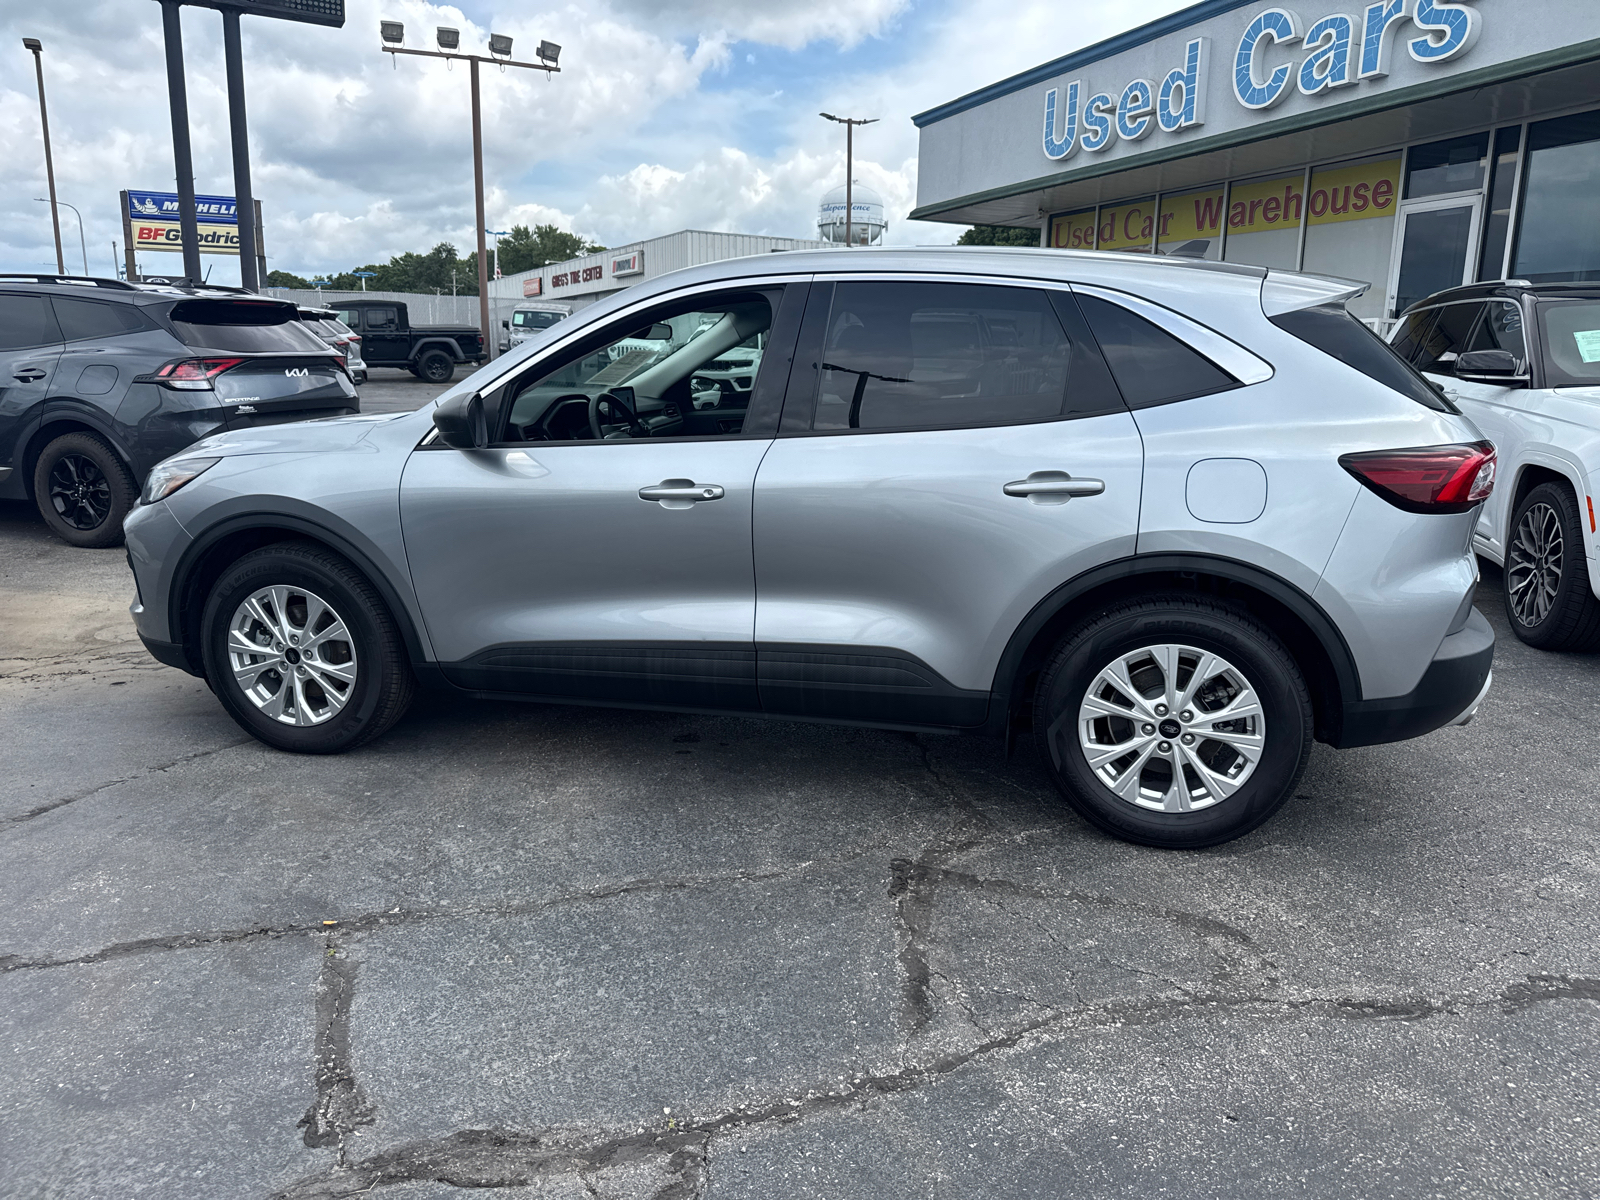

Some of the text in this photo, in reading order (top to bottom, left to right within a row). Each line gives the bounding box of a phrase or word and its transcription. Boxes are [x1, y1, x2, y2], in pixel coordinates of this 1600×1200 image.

[1043, 0, 1480, 161] Used Cars
[162, 201, 238, 215] MHELI
[1054, 179, 1394, 249] Used Car Warehouse
[138, 226, 239, 244] BFGodric
[582, 265, 602, 283] CENTER
[285, 368, 308, 377] KIA
